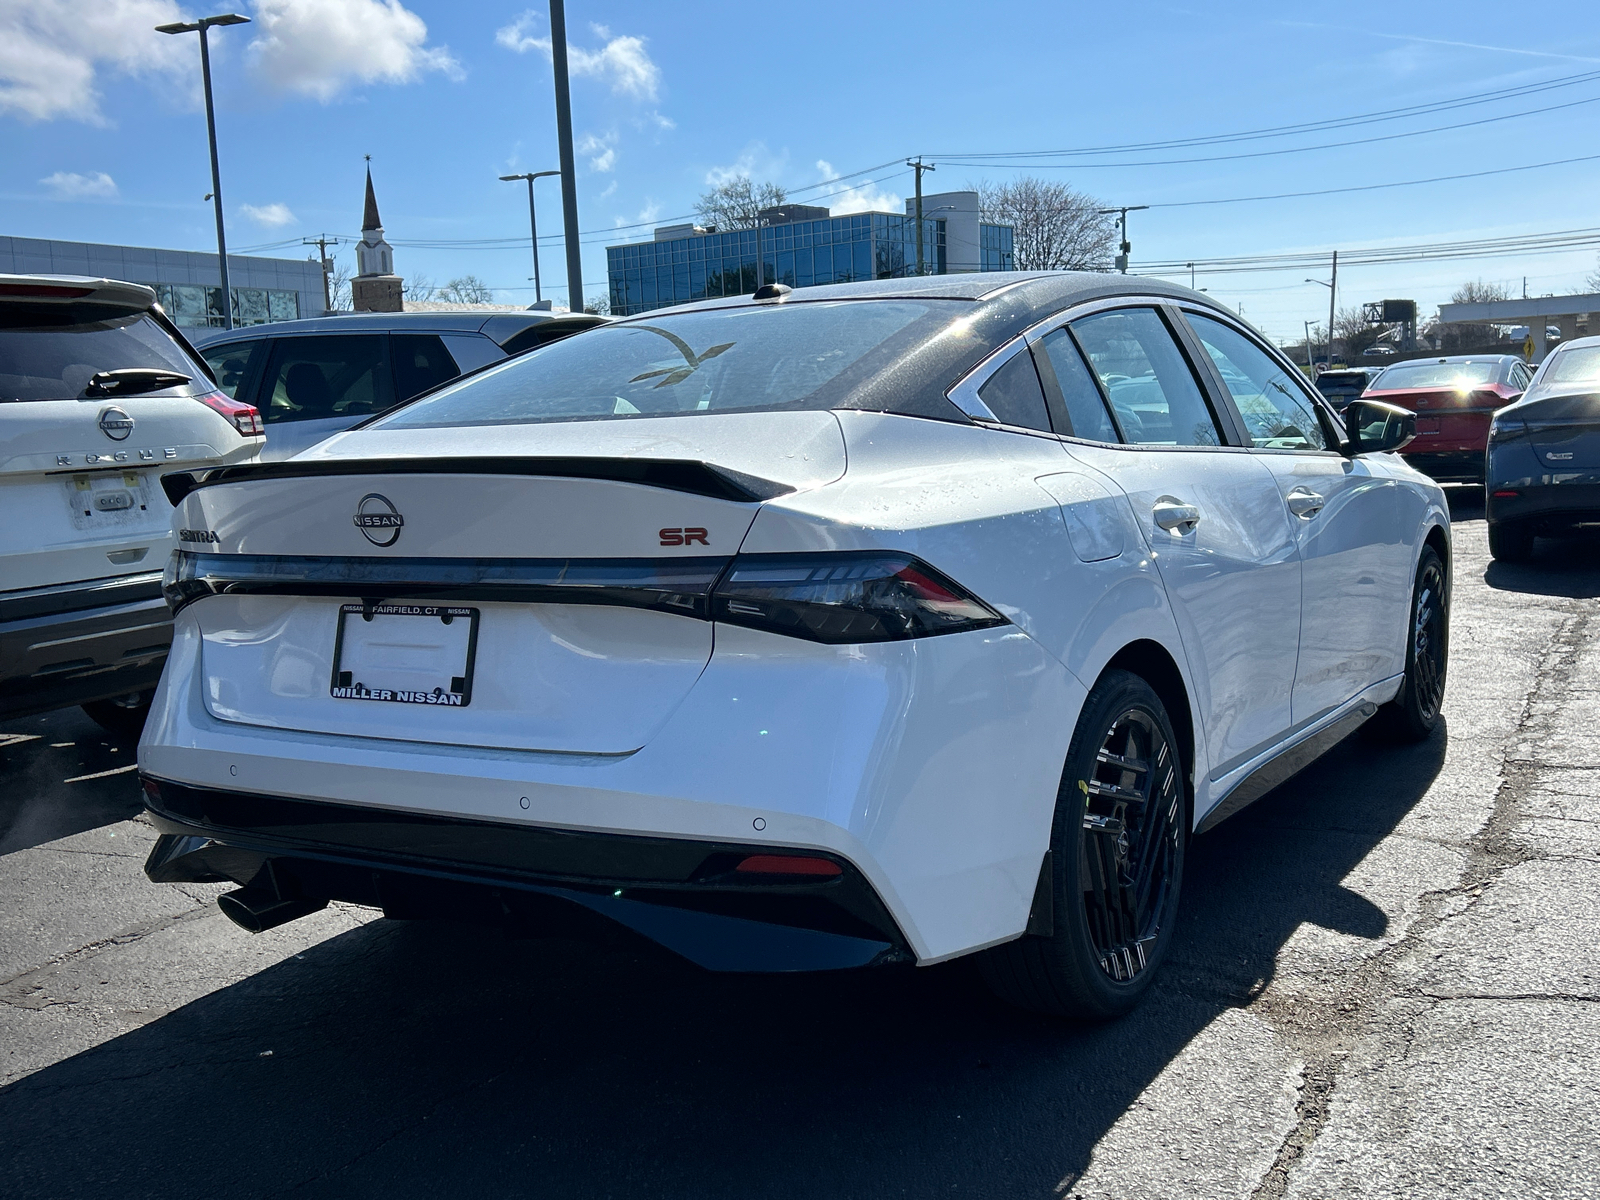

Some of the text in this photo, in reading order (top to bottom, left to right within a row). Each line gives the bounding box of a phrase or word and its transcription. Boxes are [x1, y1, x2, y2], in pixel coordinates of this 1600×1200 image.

[56, 447, 177, 466] ROGUE
[354, 516, 401, 526] NISSAN
[180, 529, 221, 543] SENTRA
[659, 527, 710, 546] SR
[372, 605, 439, 615] FAIRFIELD, CT
[332, 687, 463, 706] MILLER NISSAN
